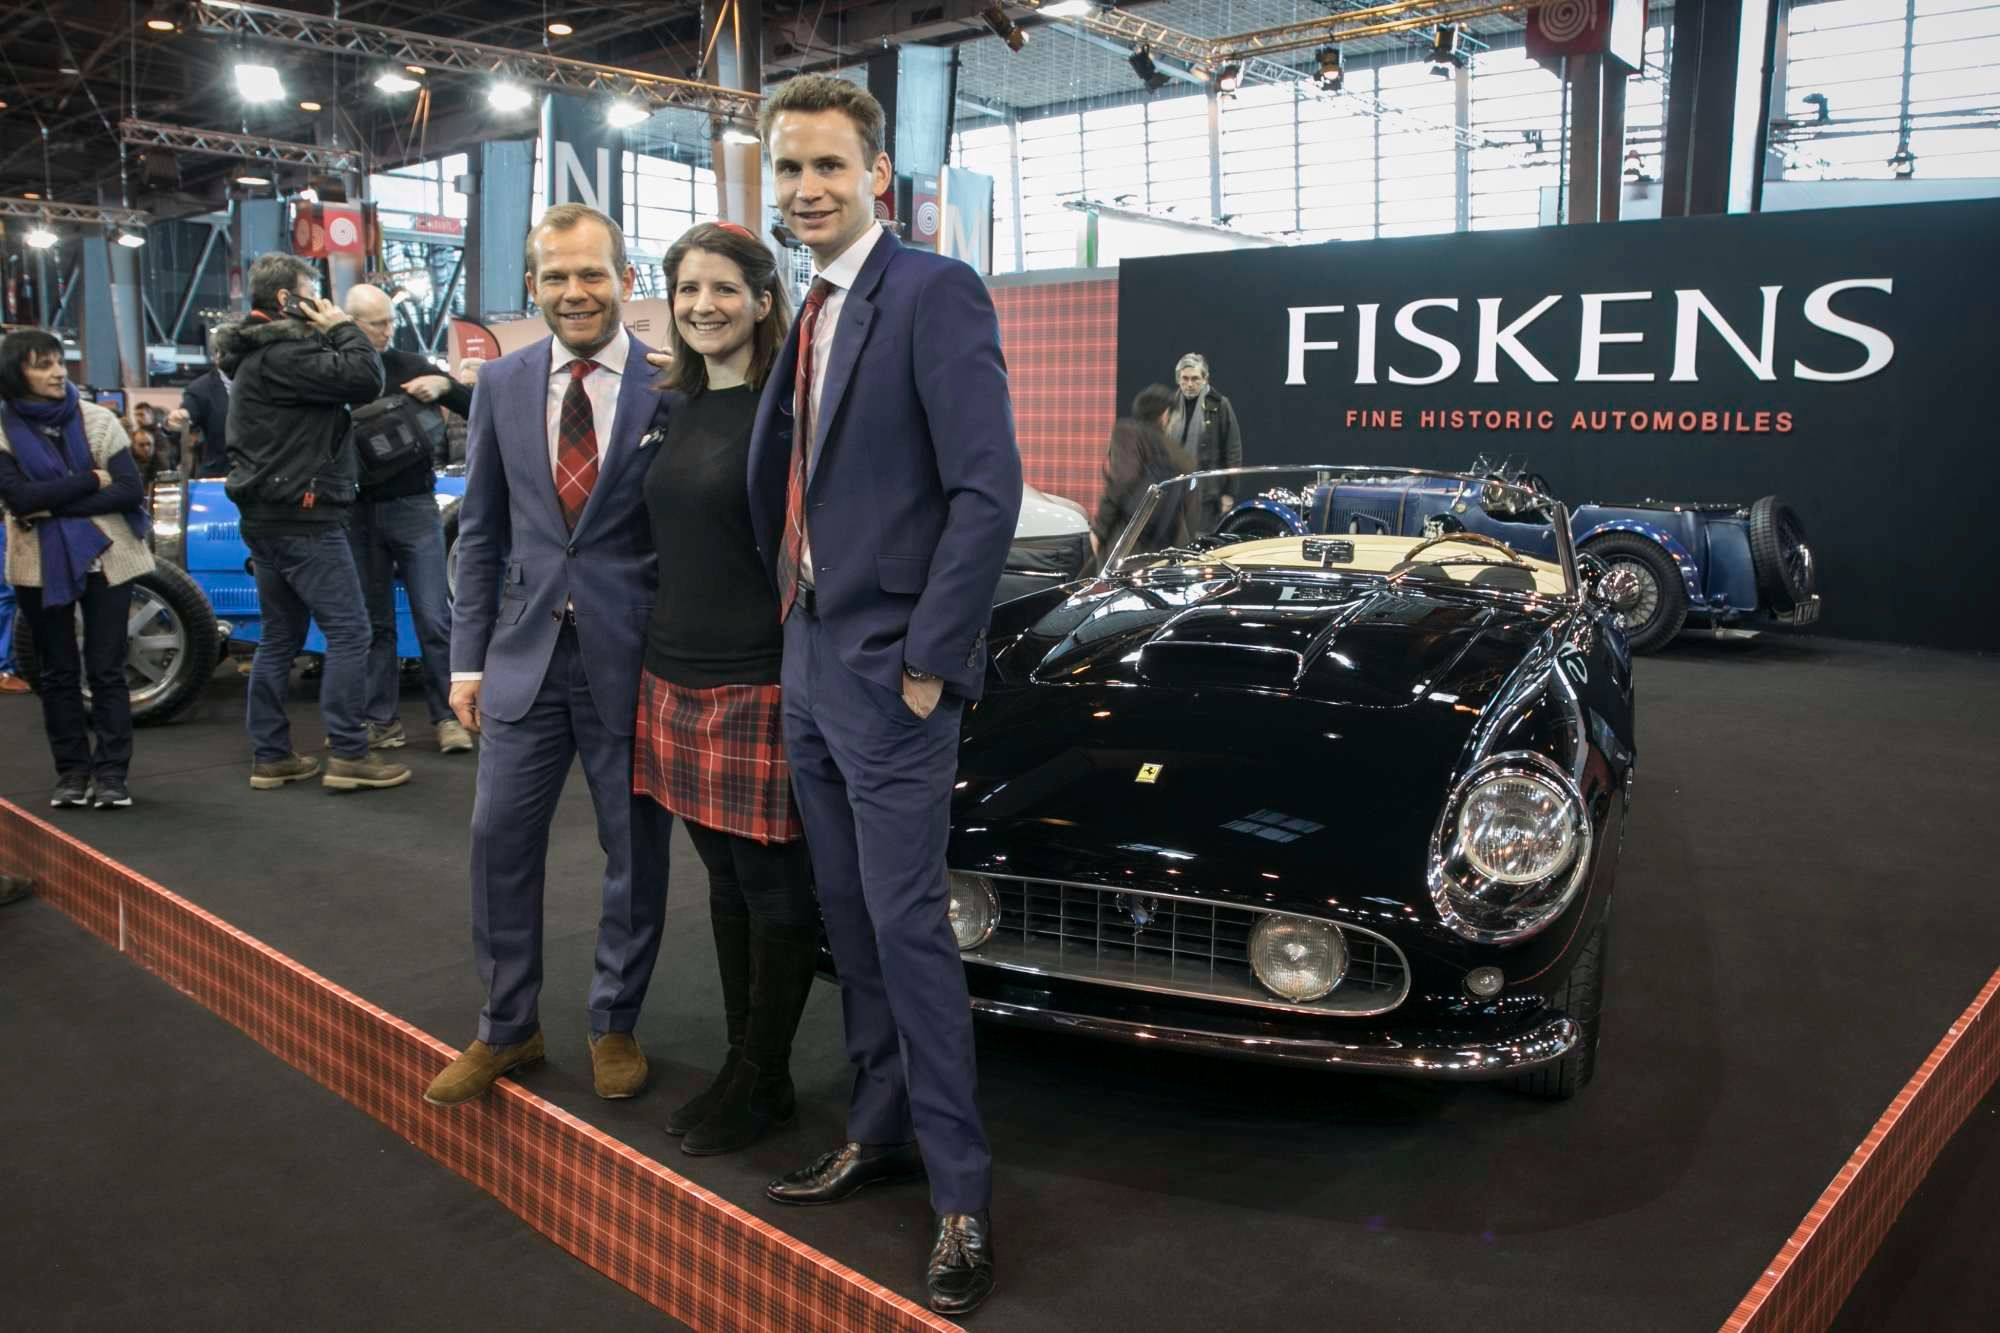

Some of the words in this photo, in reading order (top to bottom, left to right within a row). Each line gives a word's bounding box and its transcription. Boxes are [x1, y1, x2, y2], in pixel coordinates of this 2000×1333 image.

[555, 141, 609, 216] N
[1285, 279, 1895, 386] FISKENS
[1346, 411, 1403, 427] FINE
[1420, 411, 1554, 429] HISTORIC
[1571, 411, 1794, 432] AUTOMOBILES
